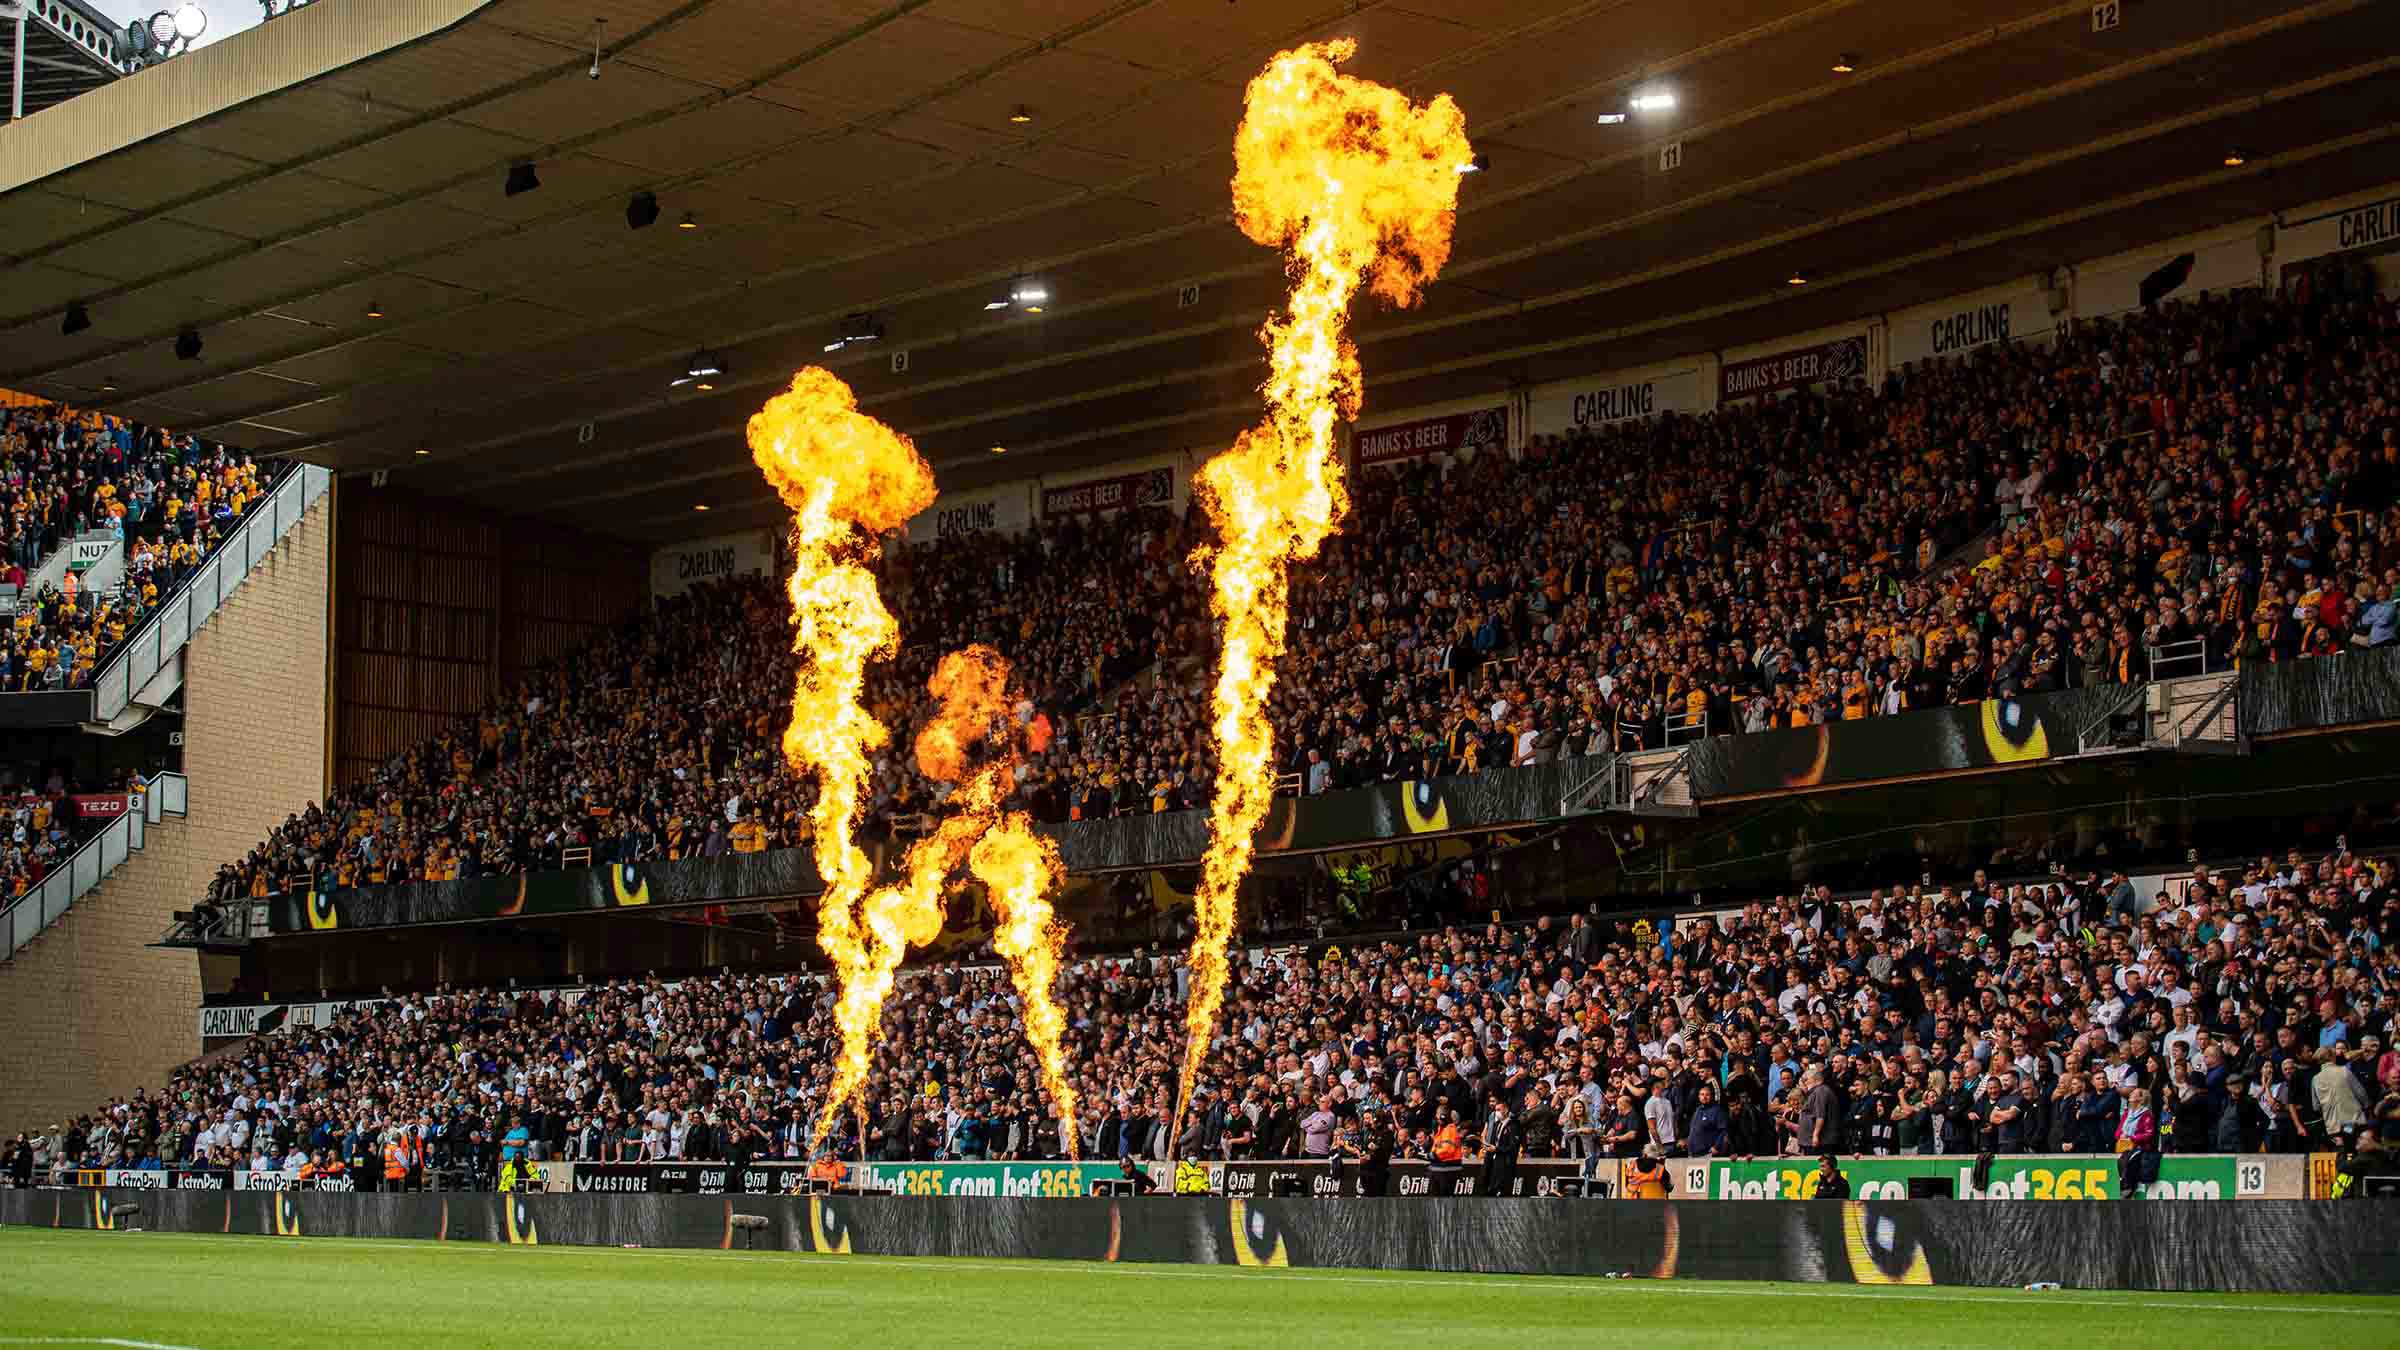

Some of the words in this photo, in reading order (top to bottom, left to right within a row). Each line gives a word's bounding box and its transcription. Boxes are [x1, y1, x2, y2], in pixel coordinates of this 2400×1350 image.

[2096, 4, 2116, 27] 12
[2340, 203, 2400, 247] CARLI
[1933, 304, 2009, 353] CARLING
[1728, 361, 1780, 392] BANKS'S
[1784, 353, 1819, 381] BEER
[1574, 384, 1653, 424] CARLING
[1416, 423, 1448, 449] BEER
[937, 504, 996, 537] CARLING
[680, 548, 735, 578] CARLING
[80, 801, 120, 811] TEZO
[131, 797, 139, 807] 6
[204, 1008, 255, 1034] CARLING
[314, 1173, 355, 1191] AstroPa
[595, 1176, 648, 1191] CASTORE
[1211, 1170, 1222, 1187] 12
[1688, 1168, 1704, 1189] 13
[2241, 1166, 2262, 1190] 13
